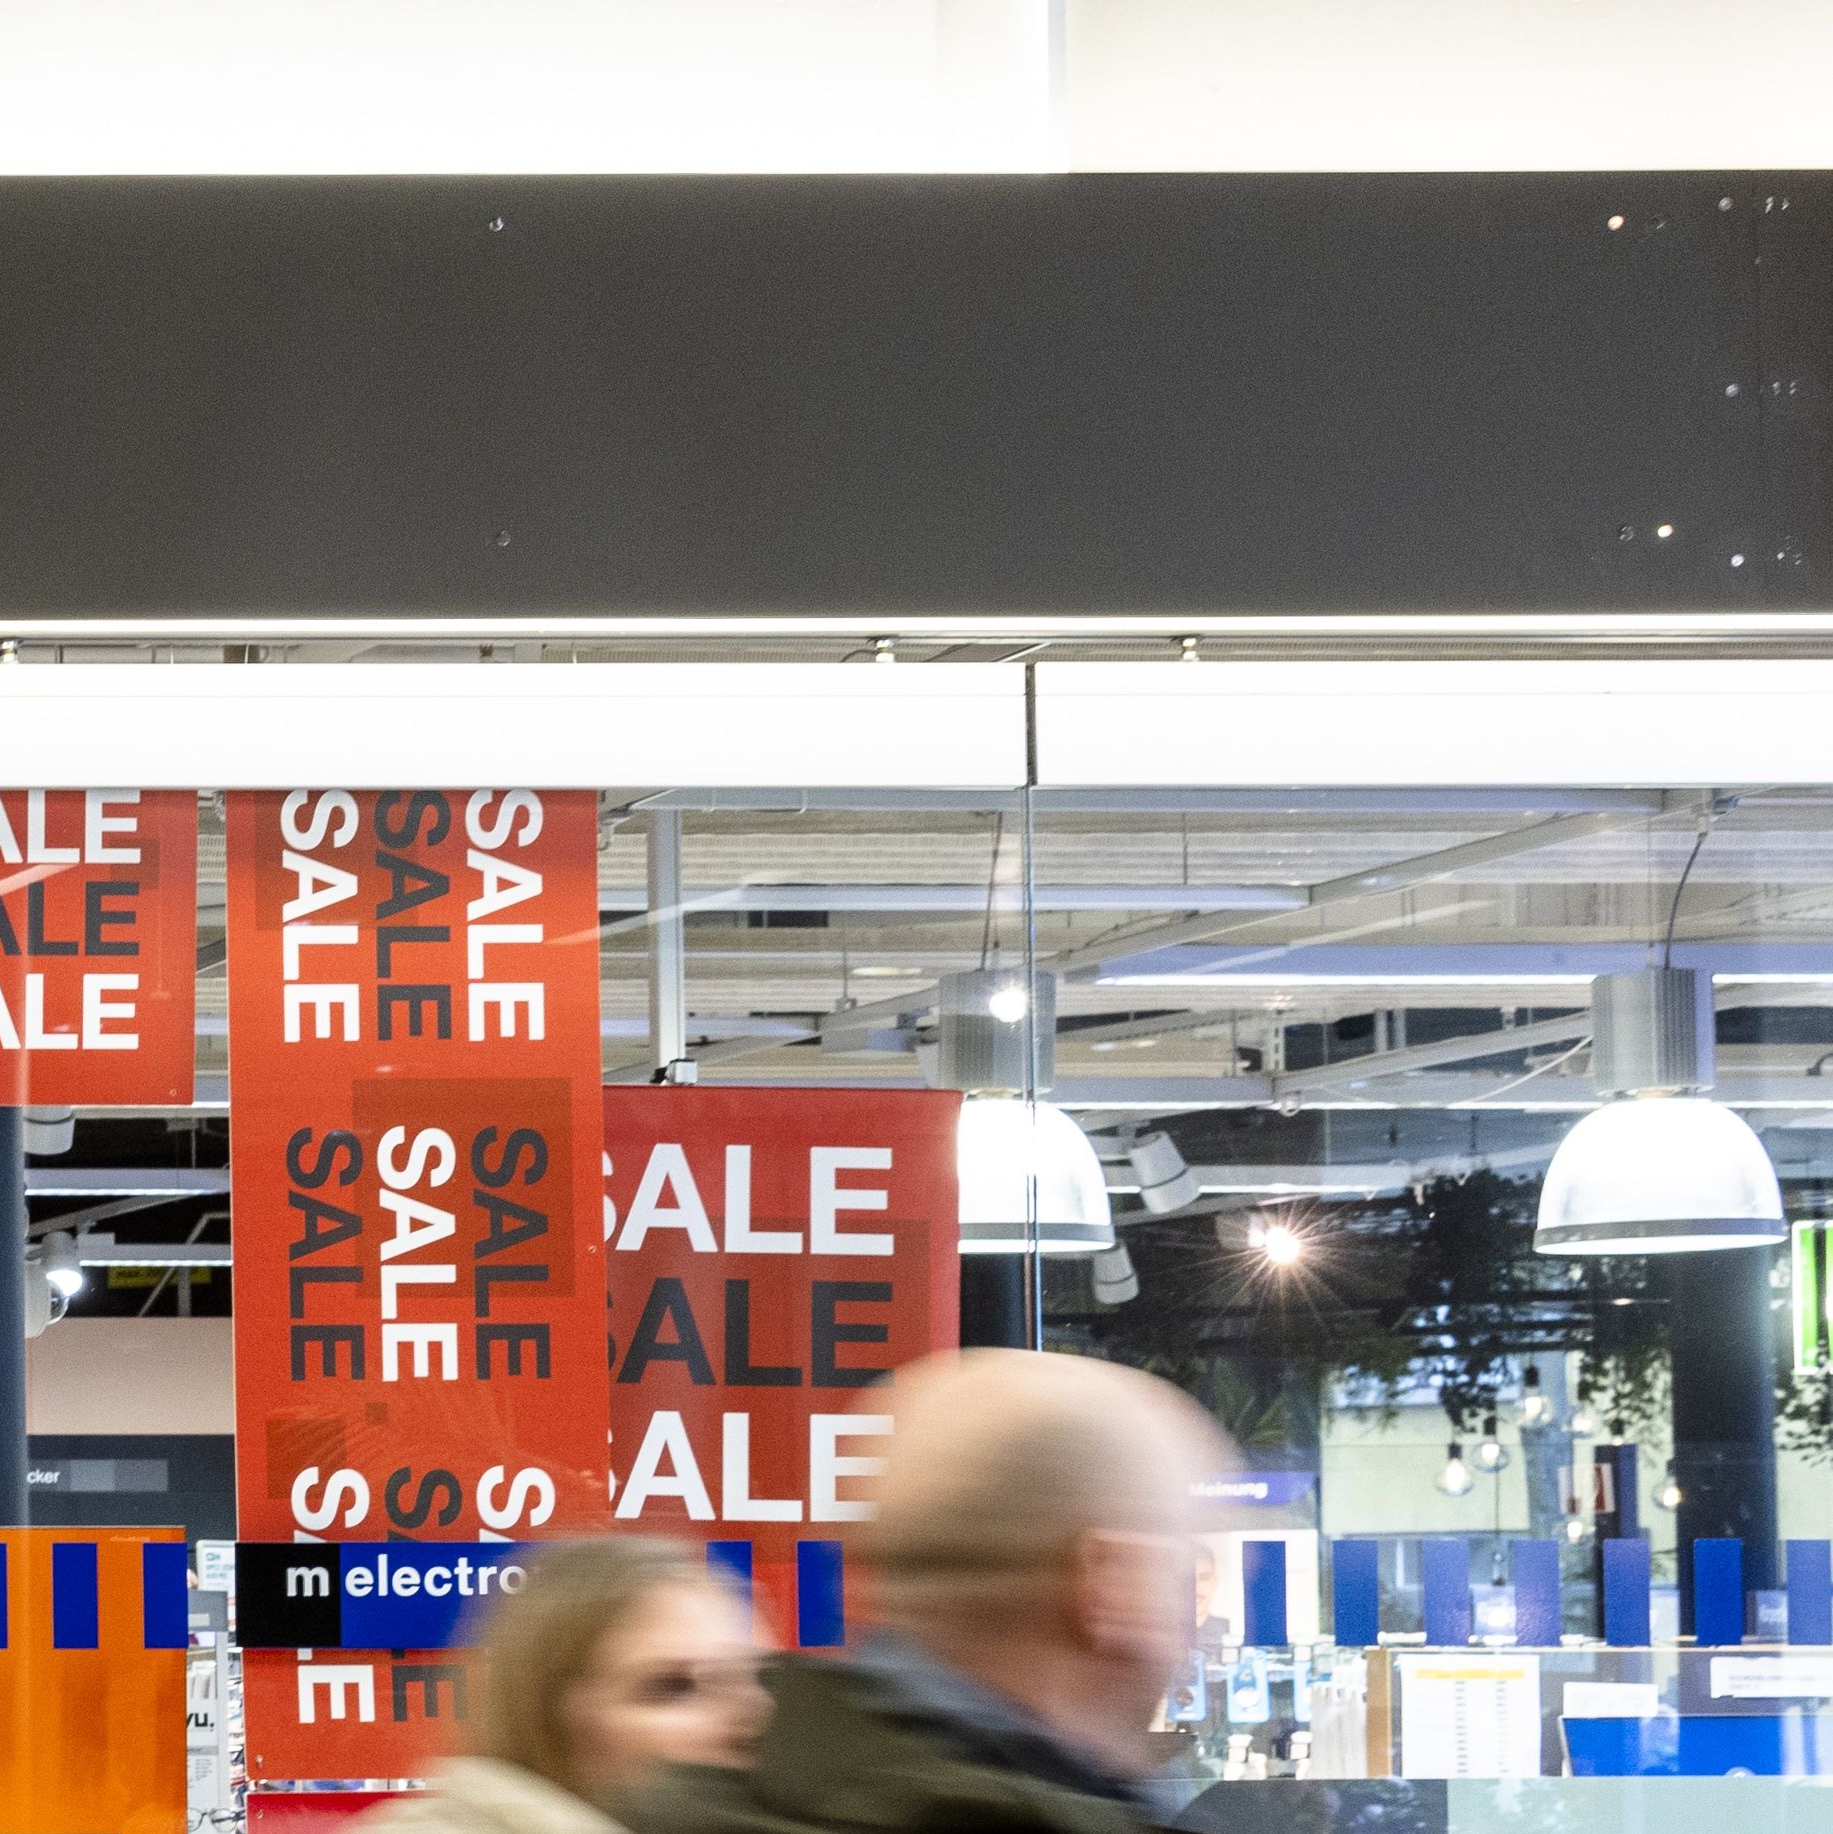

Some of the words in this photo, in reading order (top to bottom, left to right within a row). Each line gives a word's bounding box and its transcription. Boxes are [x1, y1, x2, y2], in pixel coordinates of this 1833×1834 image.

[280, 788, 361, 1043] SALE
[373, 788, 453, 1041] SALE
[464, 788, 546, 1043] SALE
[286, 1127, 366, 1382] SALE
[376, 1124, 458, 1383] SALE
[469, 1125, 552, 1381] SALE
[602, 1143, 895, 1256] ALE
[607, 1277, 894, 1388] ALE
[286, 1566, 330, 1597] m
[344, 1554, 529, 1597] electro
[608, 1411, 895, 1522] ALE
